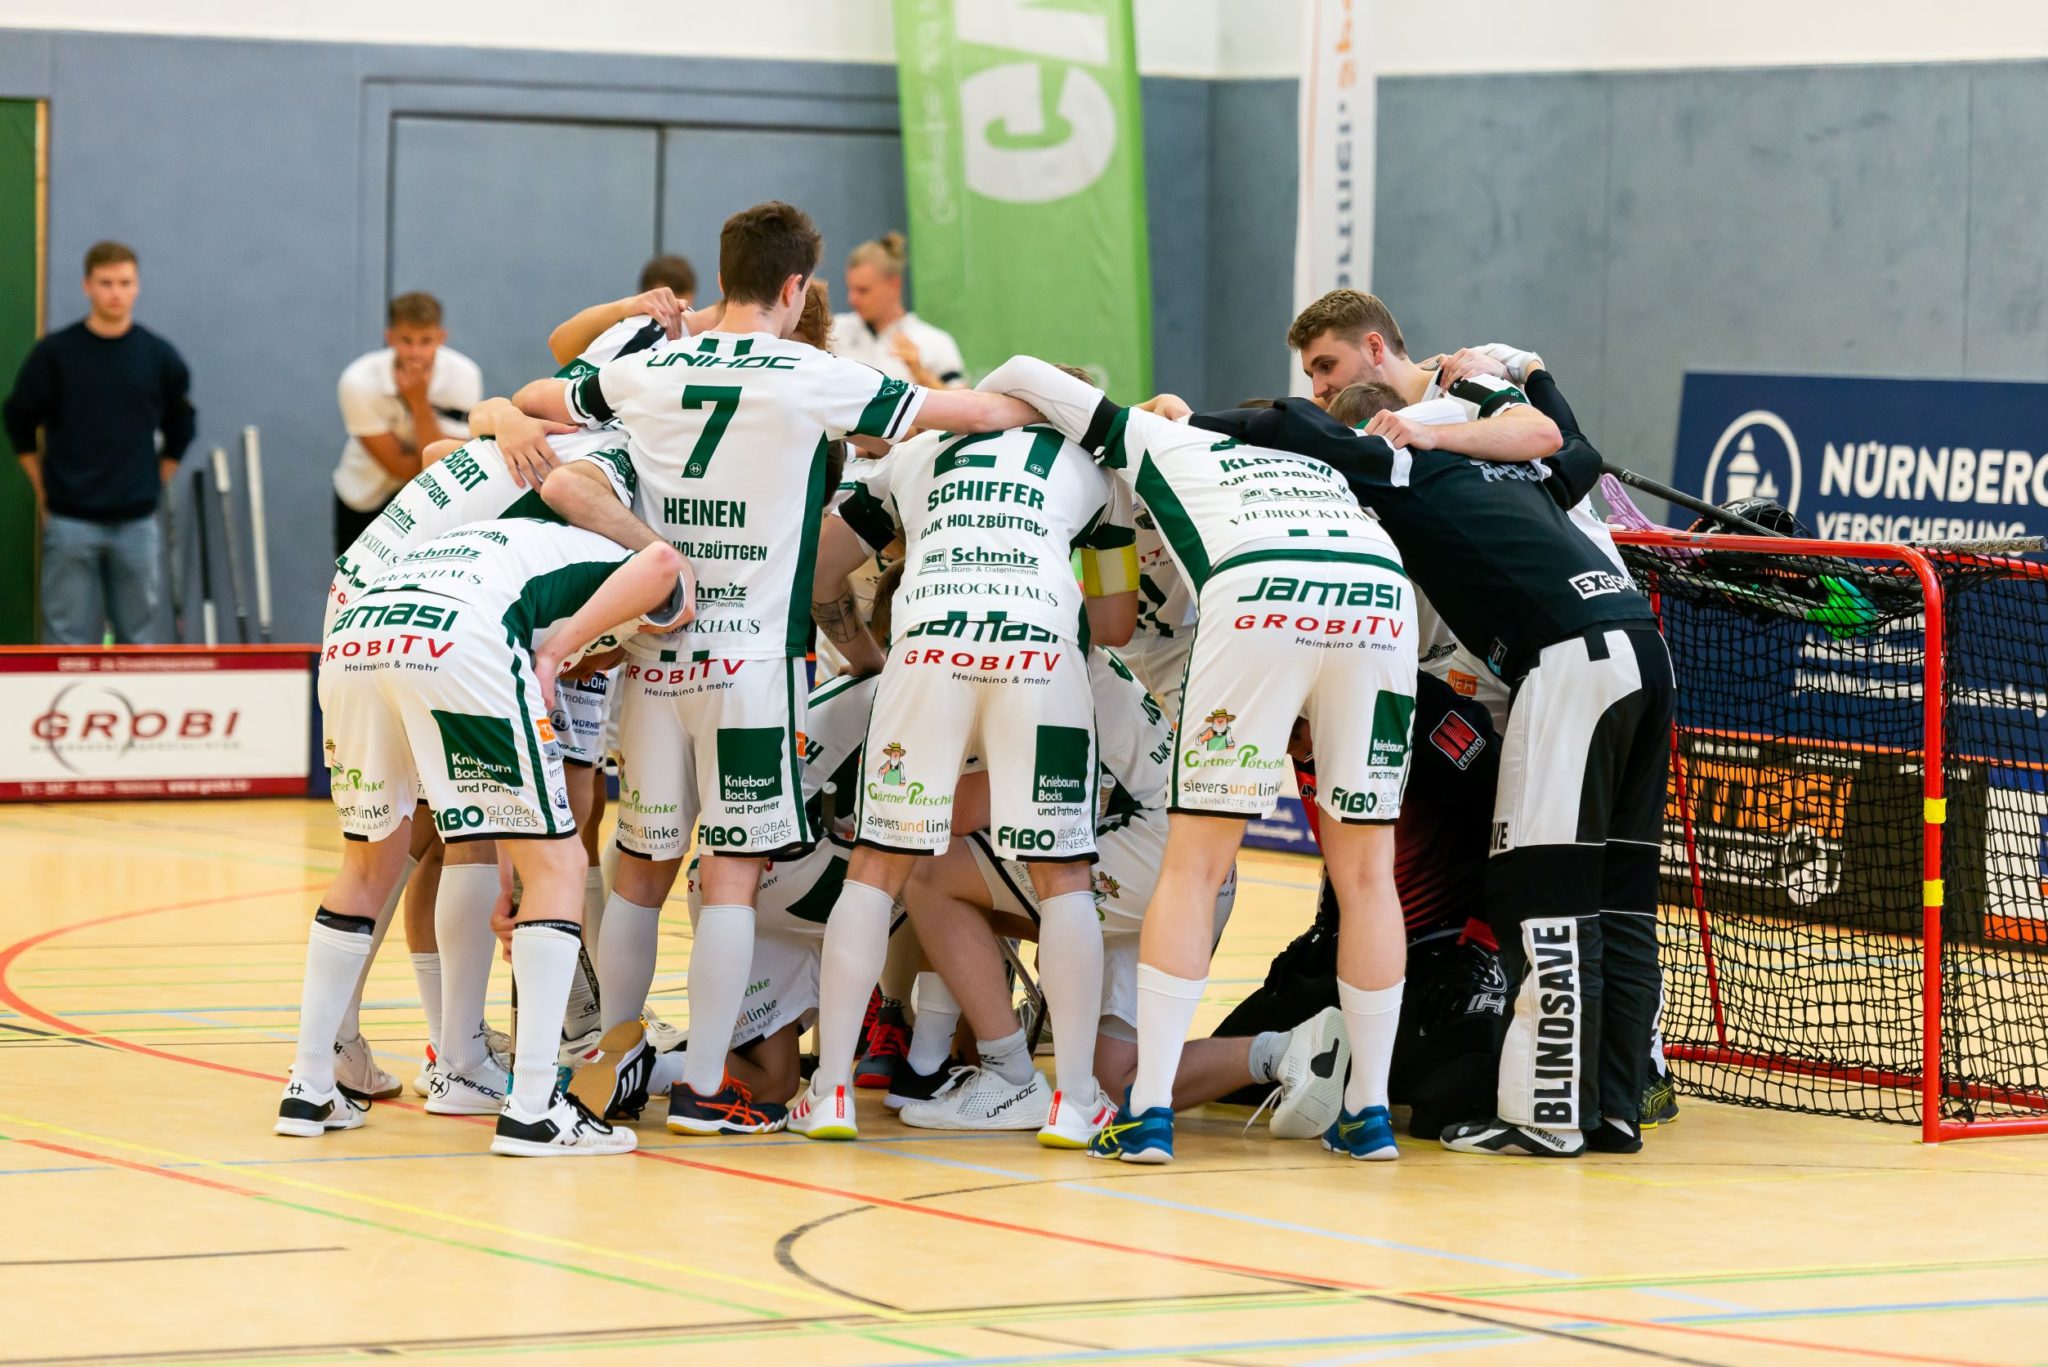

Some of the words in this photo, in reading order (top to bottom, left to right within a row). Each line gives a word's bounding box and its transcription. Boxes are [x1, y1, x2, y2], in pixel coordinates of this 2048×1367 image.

[647, 353, 801, 370] UNIHOC
[681, 384, 743, 479] 7
[928, 480, 1046, 512] SCHIFFER
[663, 497, 746, 529] HEINEN
[921, 517, 943, 540] DJK
[924, 553, 944, 564] SBT
[951, 546, 1039, 567] Schmitz
[695, 580, 748, 599] hmitz
[905, 582, 1059, 608] VIEBROCKHAUS
[1234, 613, 1404, 639] GROBITV
[1296, 636, 1353, 649] Heimkino
[1358, 640, 1366, 648] &
[1371, 641, 1397, 652] mehr
[344, 659, 390, 673] Heimkino
[394, 660, 401, 669] &
[405, 661, 440, 673] mehr
[904, 649, 1062, 672] GROBITV
[951, 672, 1007, 685] Heimkino
[1012, 676, 1020, 684] &
[1024, 677, 1051, 686] mehr
[644, 687, 695, 698] Heimkino
[706, 681, 735, 692] mehr
[31, 710, 241, 742] GROBI
[1458, 738, 1484, 768] FERNO
[454, 766, 492, 779] Bocks
[1039, 775, 1080, 789] Kniebaum
[457, 783, 480, 793] und
[725, 788, 757, 801] Bocks
[1038, 788, 1062, 801] Bocks
[725, 805, 744, 814] und
[1331, 786, 1377, 815] FIBO
[487, 805, 538, 818] GLOBAL
[1038, 806, 1056, 816] und
[488, 816, 538, 828] FITNESS
[698, 824, 747, 847] FIBO
[750, 818, 792, 836] GLOBAL
[751, 828, 792, 847] FITNESS
[998, 826, 1055, 851] FIBO
[1057, 827, 1088, 839] GLOBAL
[1055, 838, 1090, 850] FITNESS
[1532, 925, 1576, 1124] BLINDSAVE
[446, 1072, 505, 1101] UNIHOC
[986, 1082, 1038, 1119] UNIHOC
